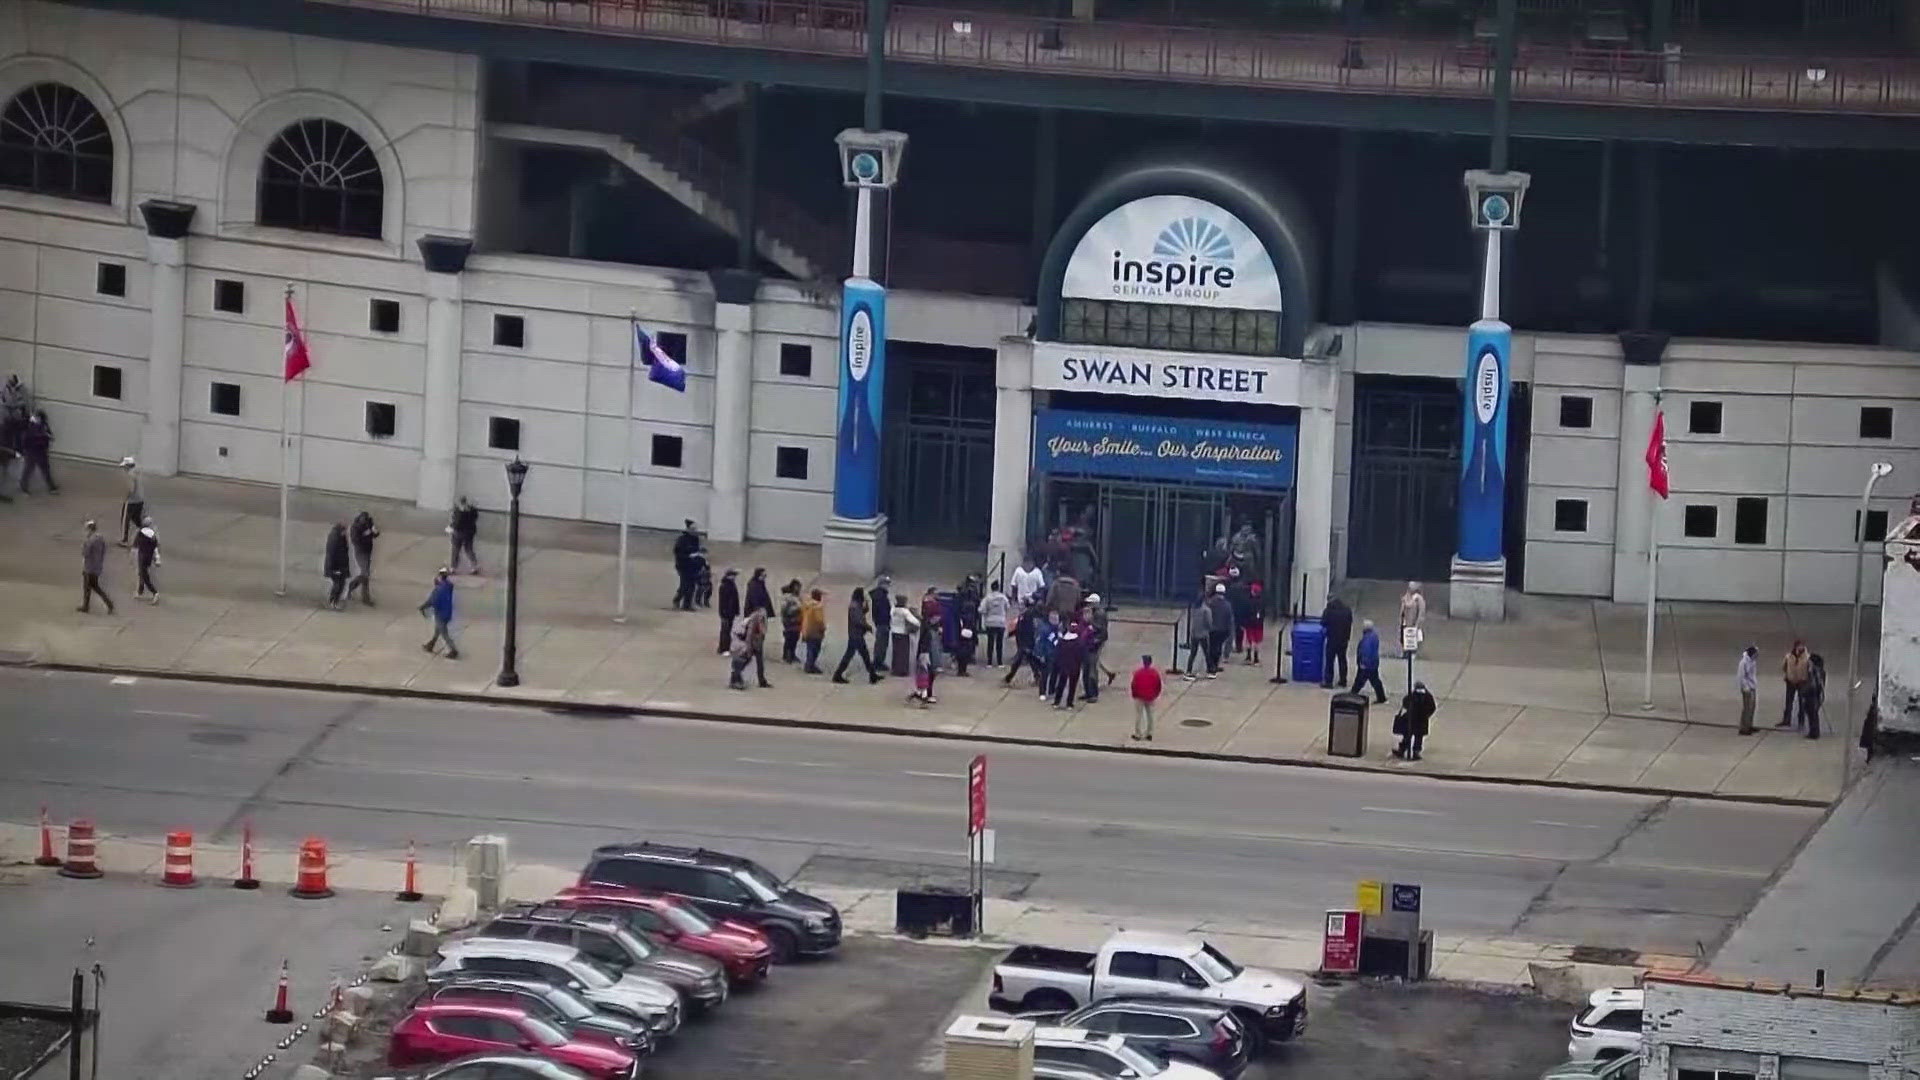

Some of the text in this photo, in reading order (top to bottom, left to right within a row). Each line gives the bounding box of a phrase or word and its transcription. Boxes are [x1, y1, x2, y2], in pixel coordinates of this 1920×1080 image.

[1113, 250, 1235, 292] inspire
[1112, 285, 1221, 300] DENTAL GROUP
[852, 326, 865, 368] inspire
[1062, 358, 1269, 394] SWAN STREET
[1482, 368, 1496, 410] inspire
[1066, 420, 1266, 441] AMHERST BUFFALO WEST SENECA
[1047, 436, 1091, 458] Your
[1157, 440, 1190, 458] Our
[1191, 441, 1283, 462] Inspiration
